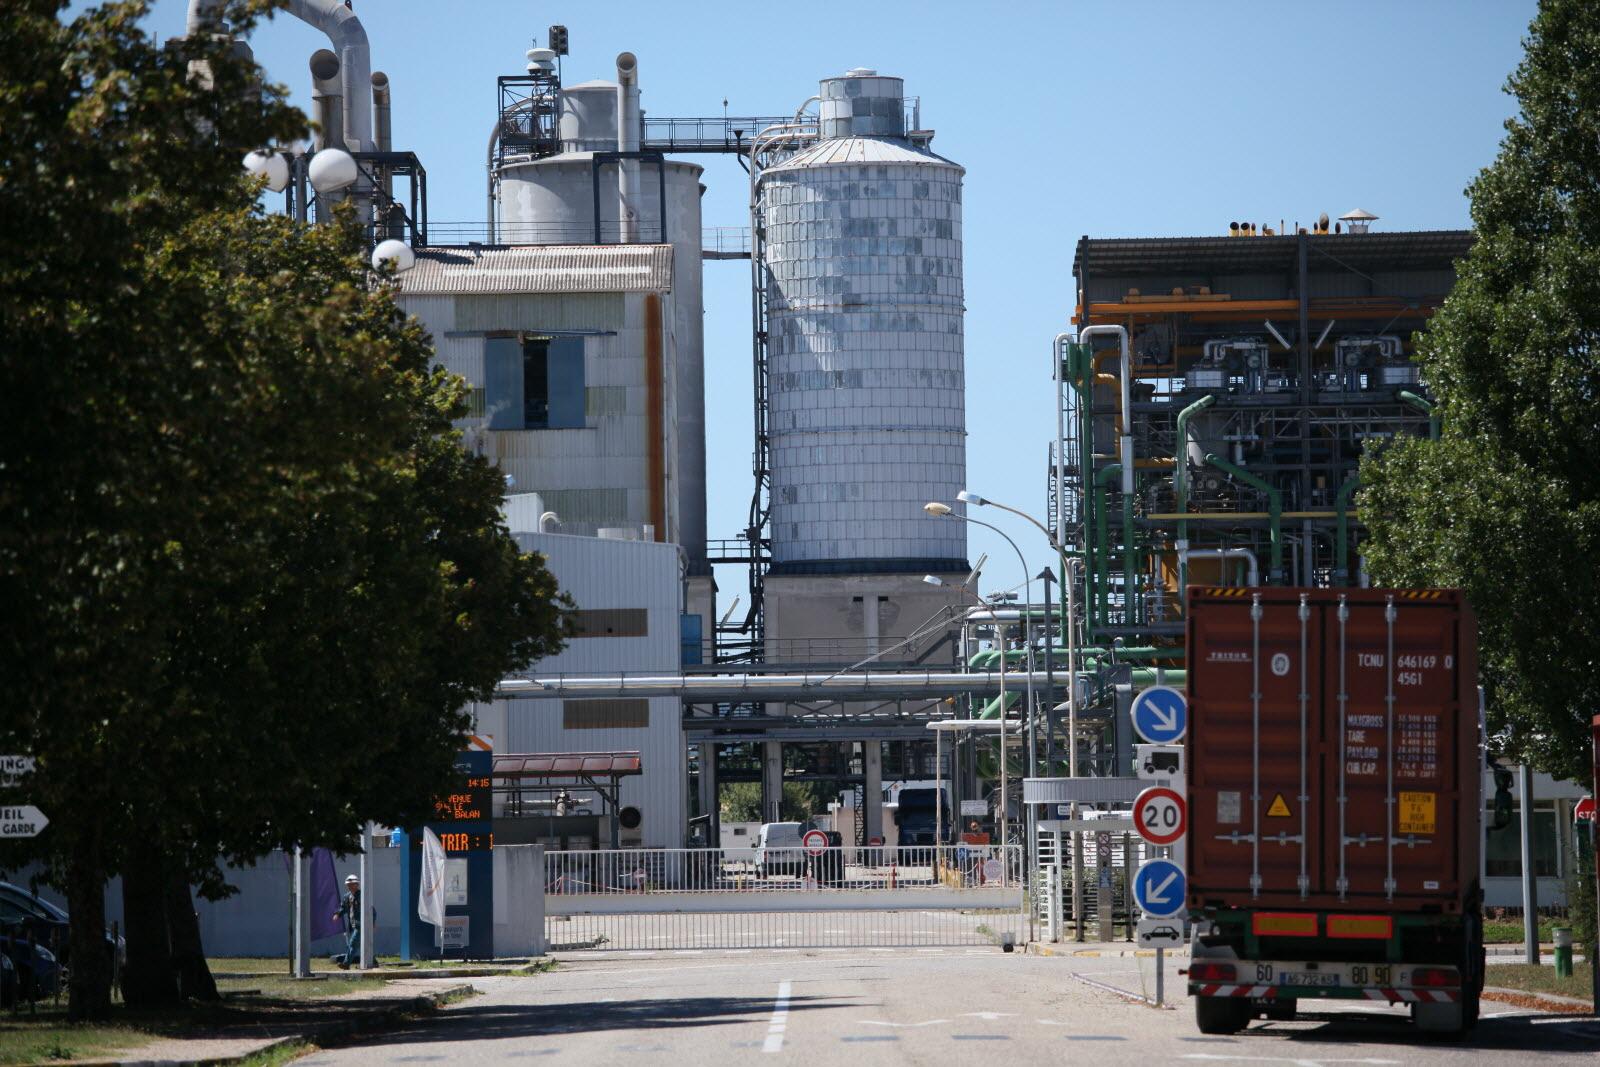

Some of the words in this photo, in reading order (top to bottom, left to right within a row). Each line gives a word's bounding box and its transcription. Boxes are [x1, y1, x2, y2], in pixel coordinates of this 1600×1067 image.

[1358, 654, 1384, 667] TCNU
[1398, 656, 1437, 669] 646169
[1347, 730, 1365, 743] TARE
[0, 809, 24, 820] EIL
[1145, 805, 1178, 827] 20
[3, 824, 36, 834] GARDE
[1256, 964, 1273, 982] 60
[1352, 966, 1368, 985] 80
[1374, 966, 1391, 985] 90
